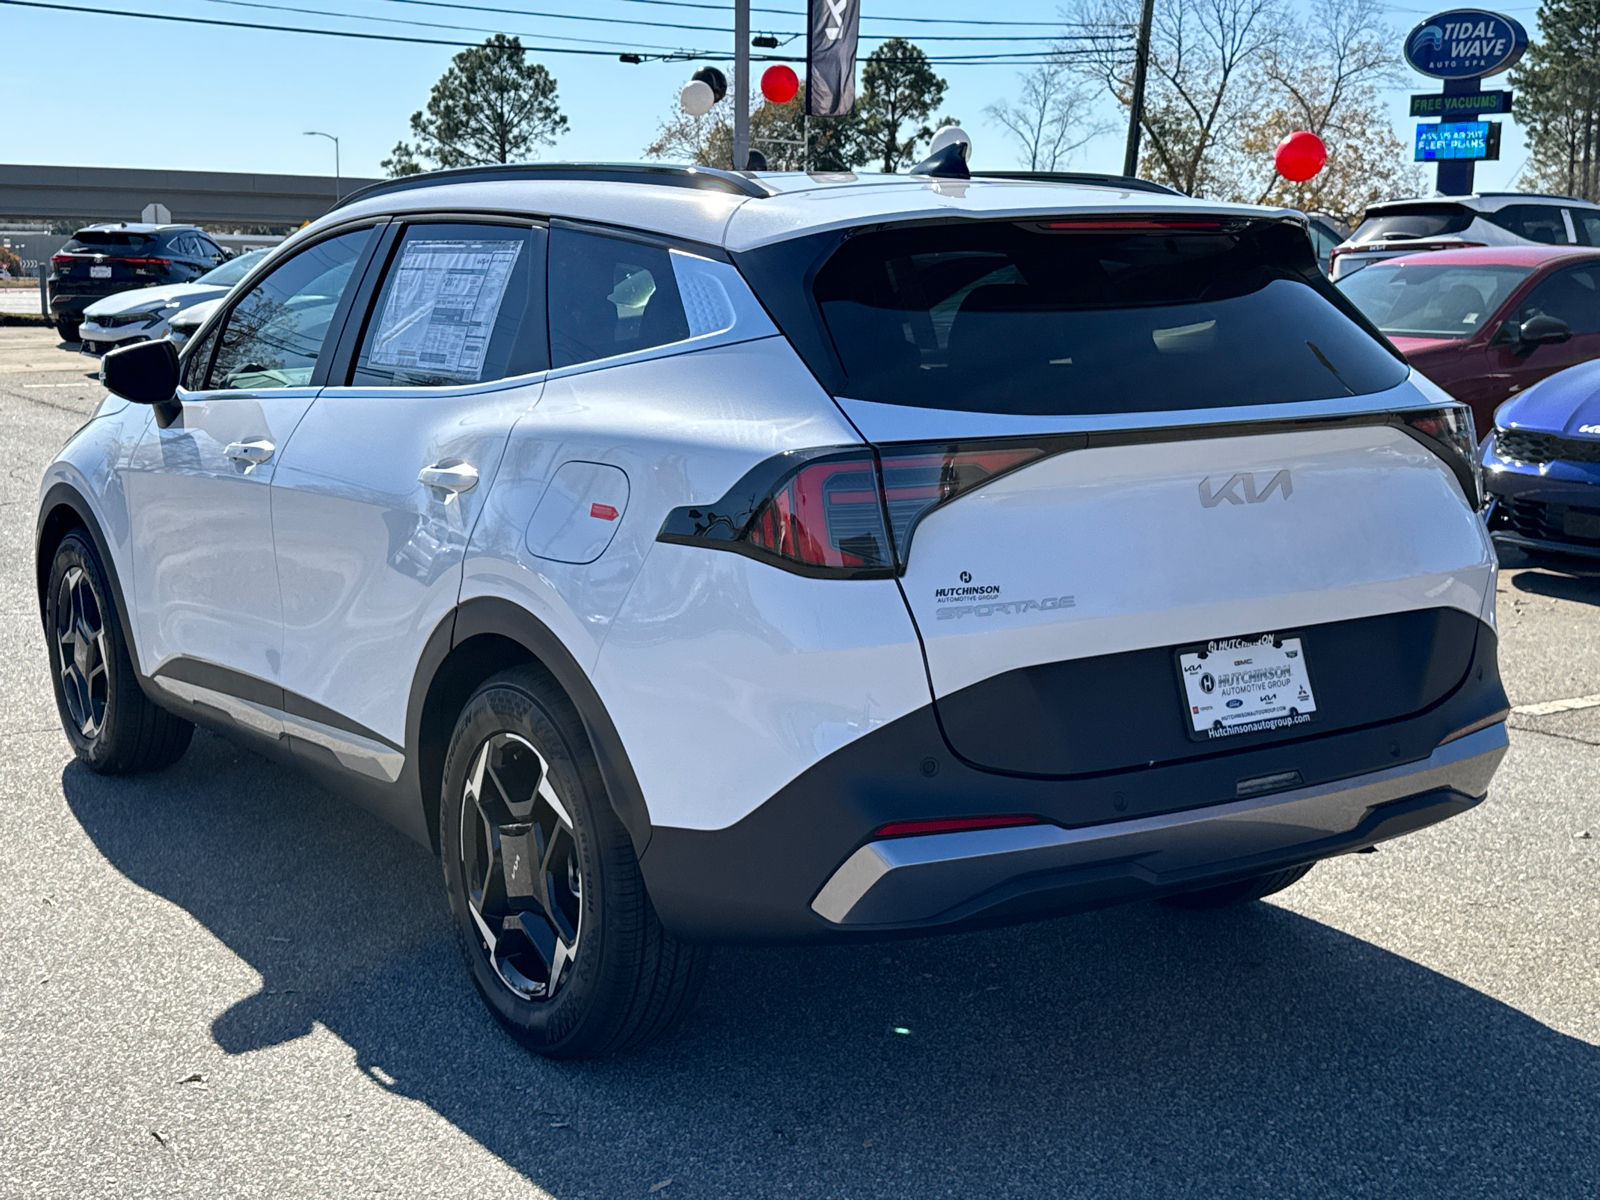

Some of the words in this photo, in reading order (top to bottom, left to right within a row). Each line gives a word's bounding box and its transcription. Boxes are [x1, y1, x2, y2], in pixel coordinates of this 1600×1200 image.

[1444, 21, 1496, 40] TIDAL
[1451, 38, 1506, 58] WAVE
[1428, 61, 1457, 69] AUTO
[1464, 59, 1486, 67] SPA
[1413, 98, 1442, 111] FREE
[1444, 95, 1497, 110] VACUUMS
[1198, 469, 1294, 509] KIA
[935, 585, 1000, 597] HUTCHINSON
[937, 595, 977, 604] AUTOMOTIVE
[935, 595, 1077, 620] SPORTAGE
[1218, 664, 1293, 688] HUTCHINSON
[1221, 683, 1266, 697] AUTOMOTIVE
[1267, 678, 1291, 689] GROUP
[1208, 713, 1311, 739] Hutchinsonautogroup.com
[586, 870, 595, 914] 103H
